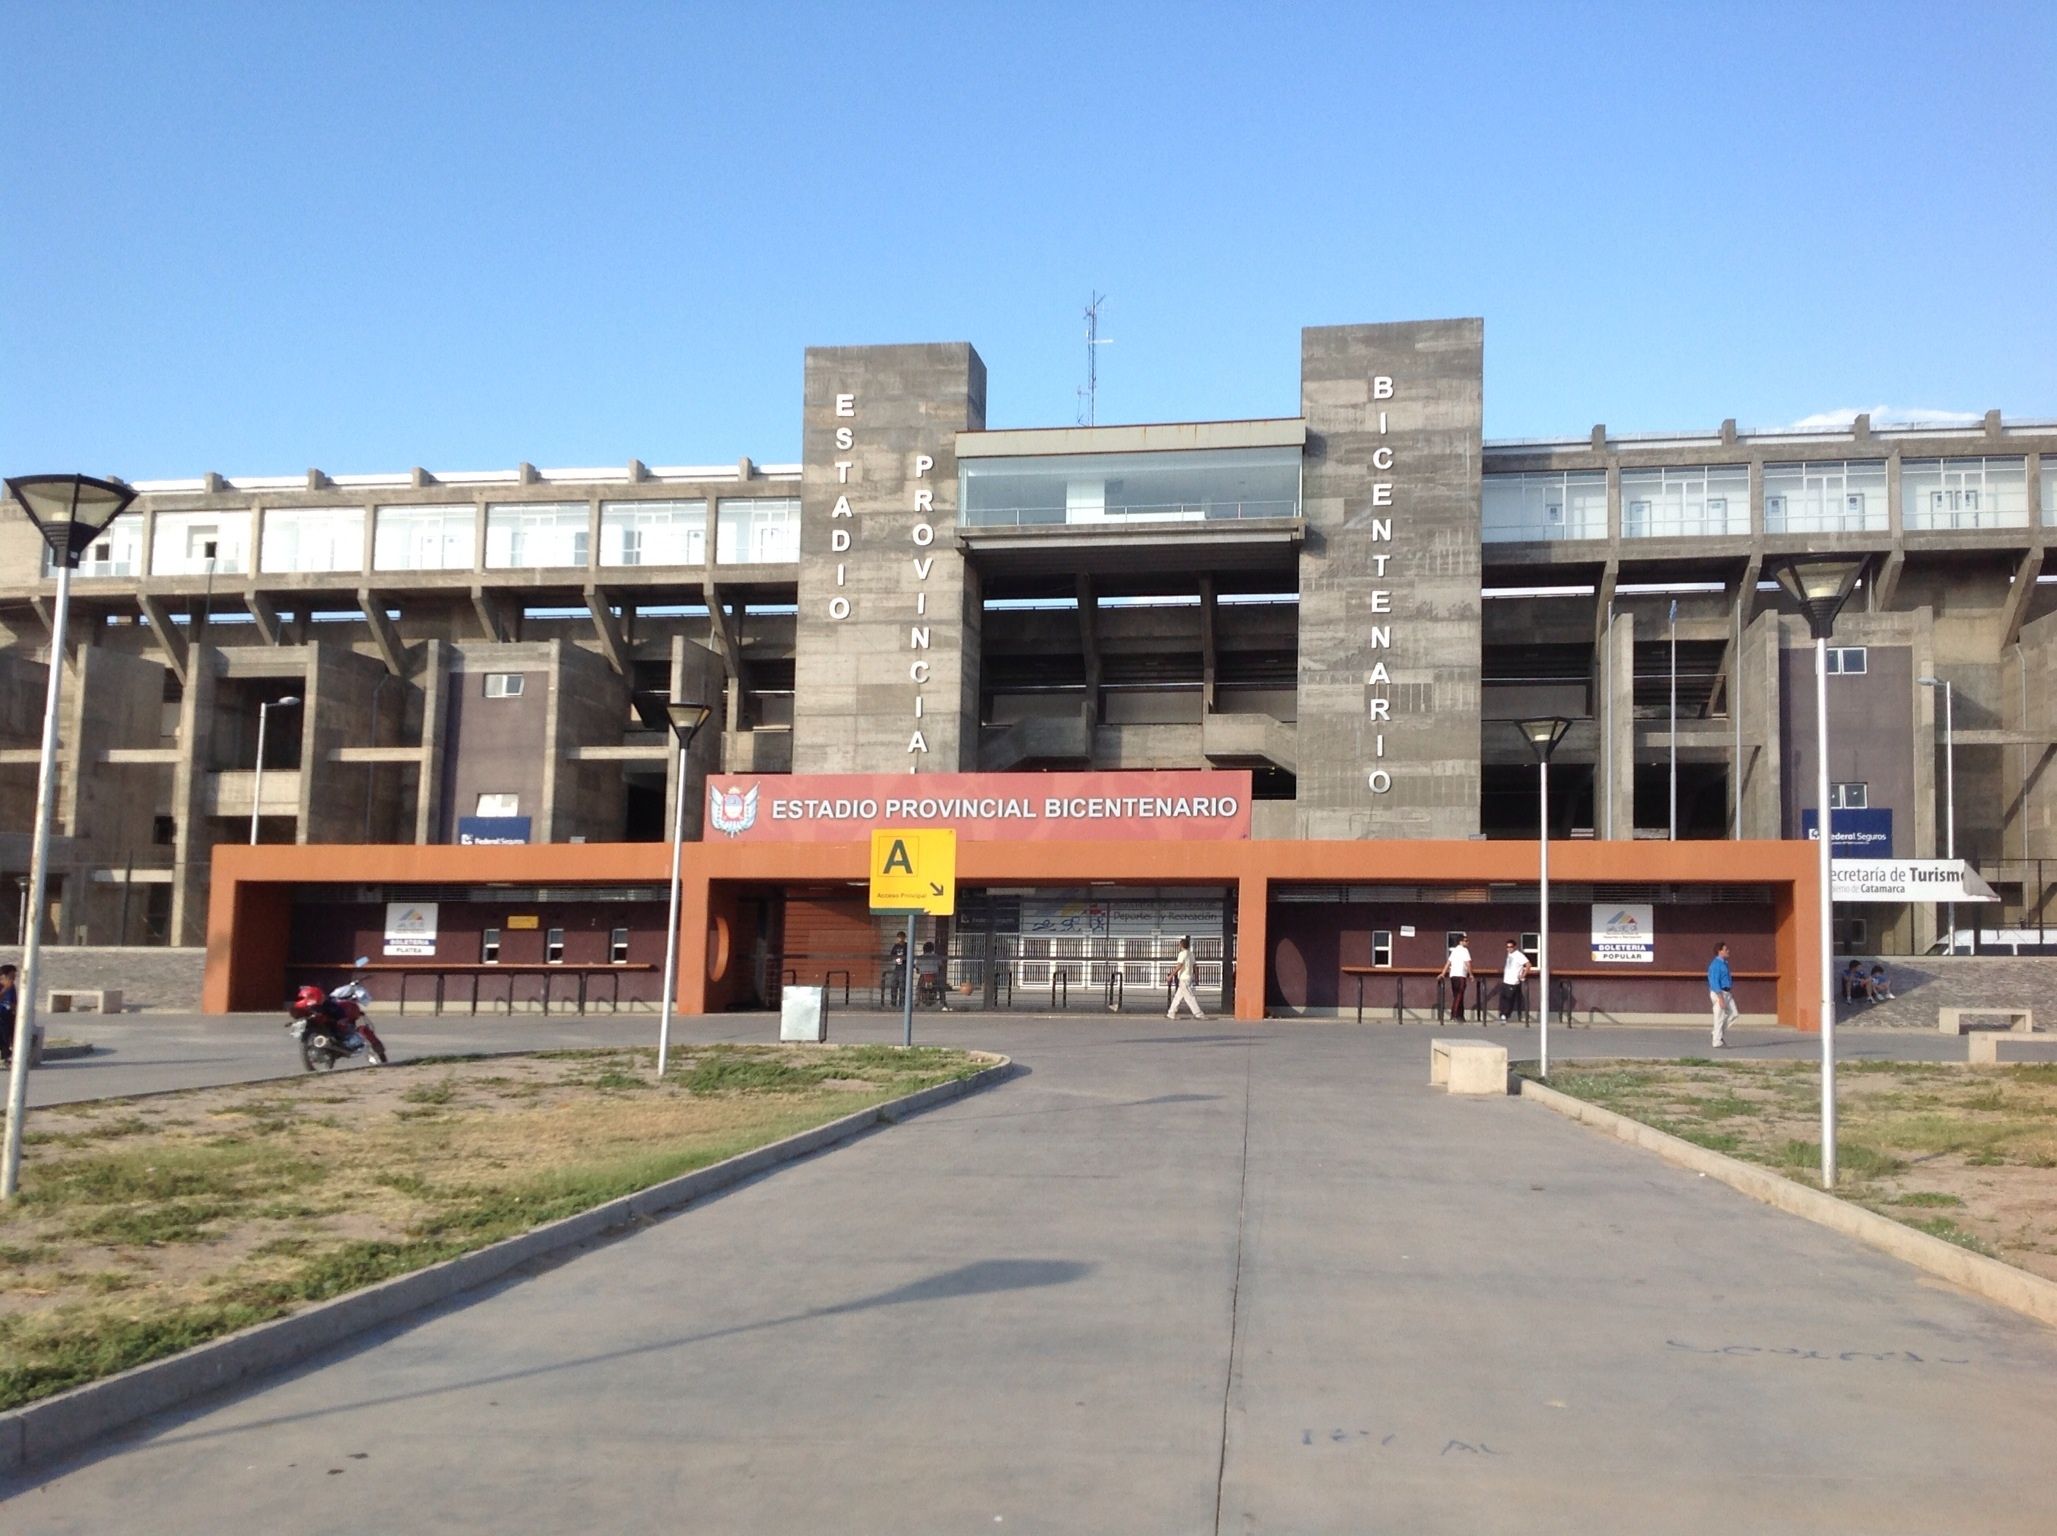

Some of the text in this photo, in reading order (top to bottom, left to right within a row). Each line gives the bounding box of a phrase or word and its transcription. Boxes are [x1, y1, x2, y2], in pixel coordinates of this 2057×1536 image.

[828, 392, 857, 621] ESTADIO
[1368, 376, 1394, 796] BICENTENARIO
[907, 454, 935, 775] PROVINCIA
[771, 796, 1238, 819] ESTADIO PROVINCIAL BICENTENARIO
[1831, 832, 1887, 842] ederal Seguros
[882, 839, 914, 875] A
[1831, 866, 1887, 882] ecretaría
[1890, 866, 1906, 882] de
[1860, 883, 1905, 894] Catamarca
